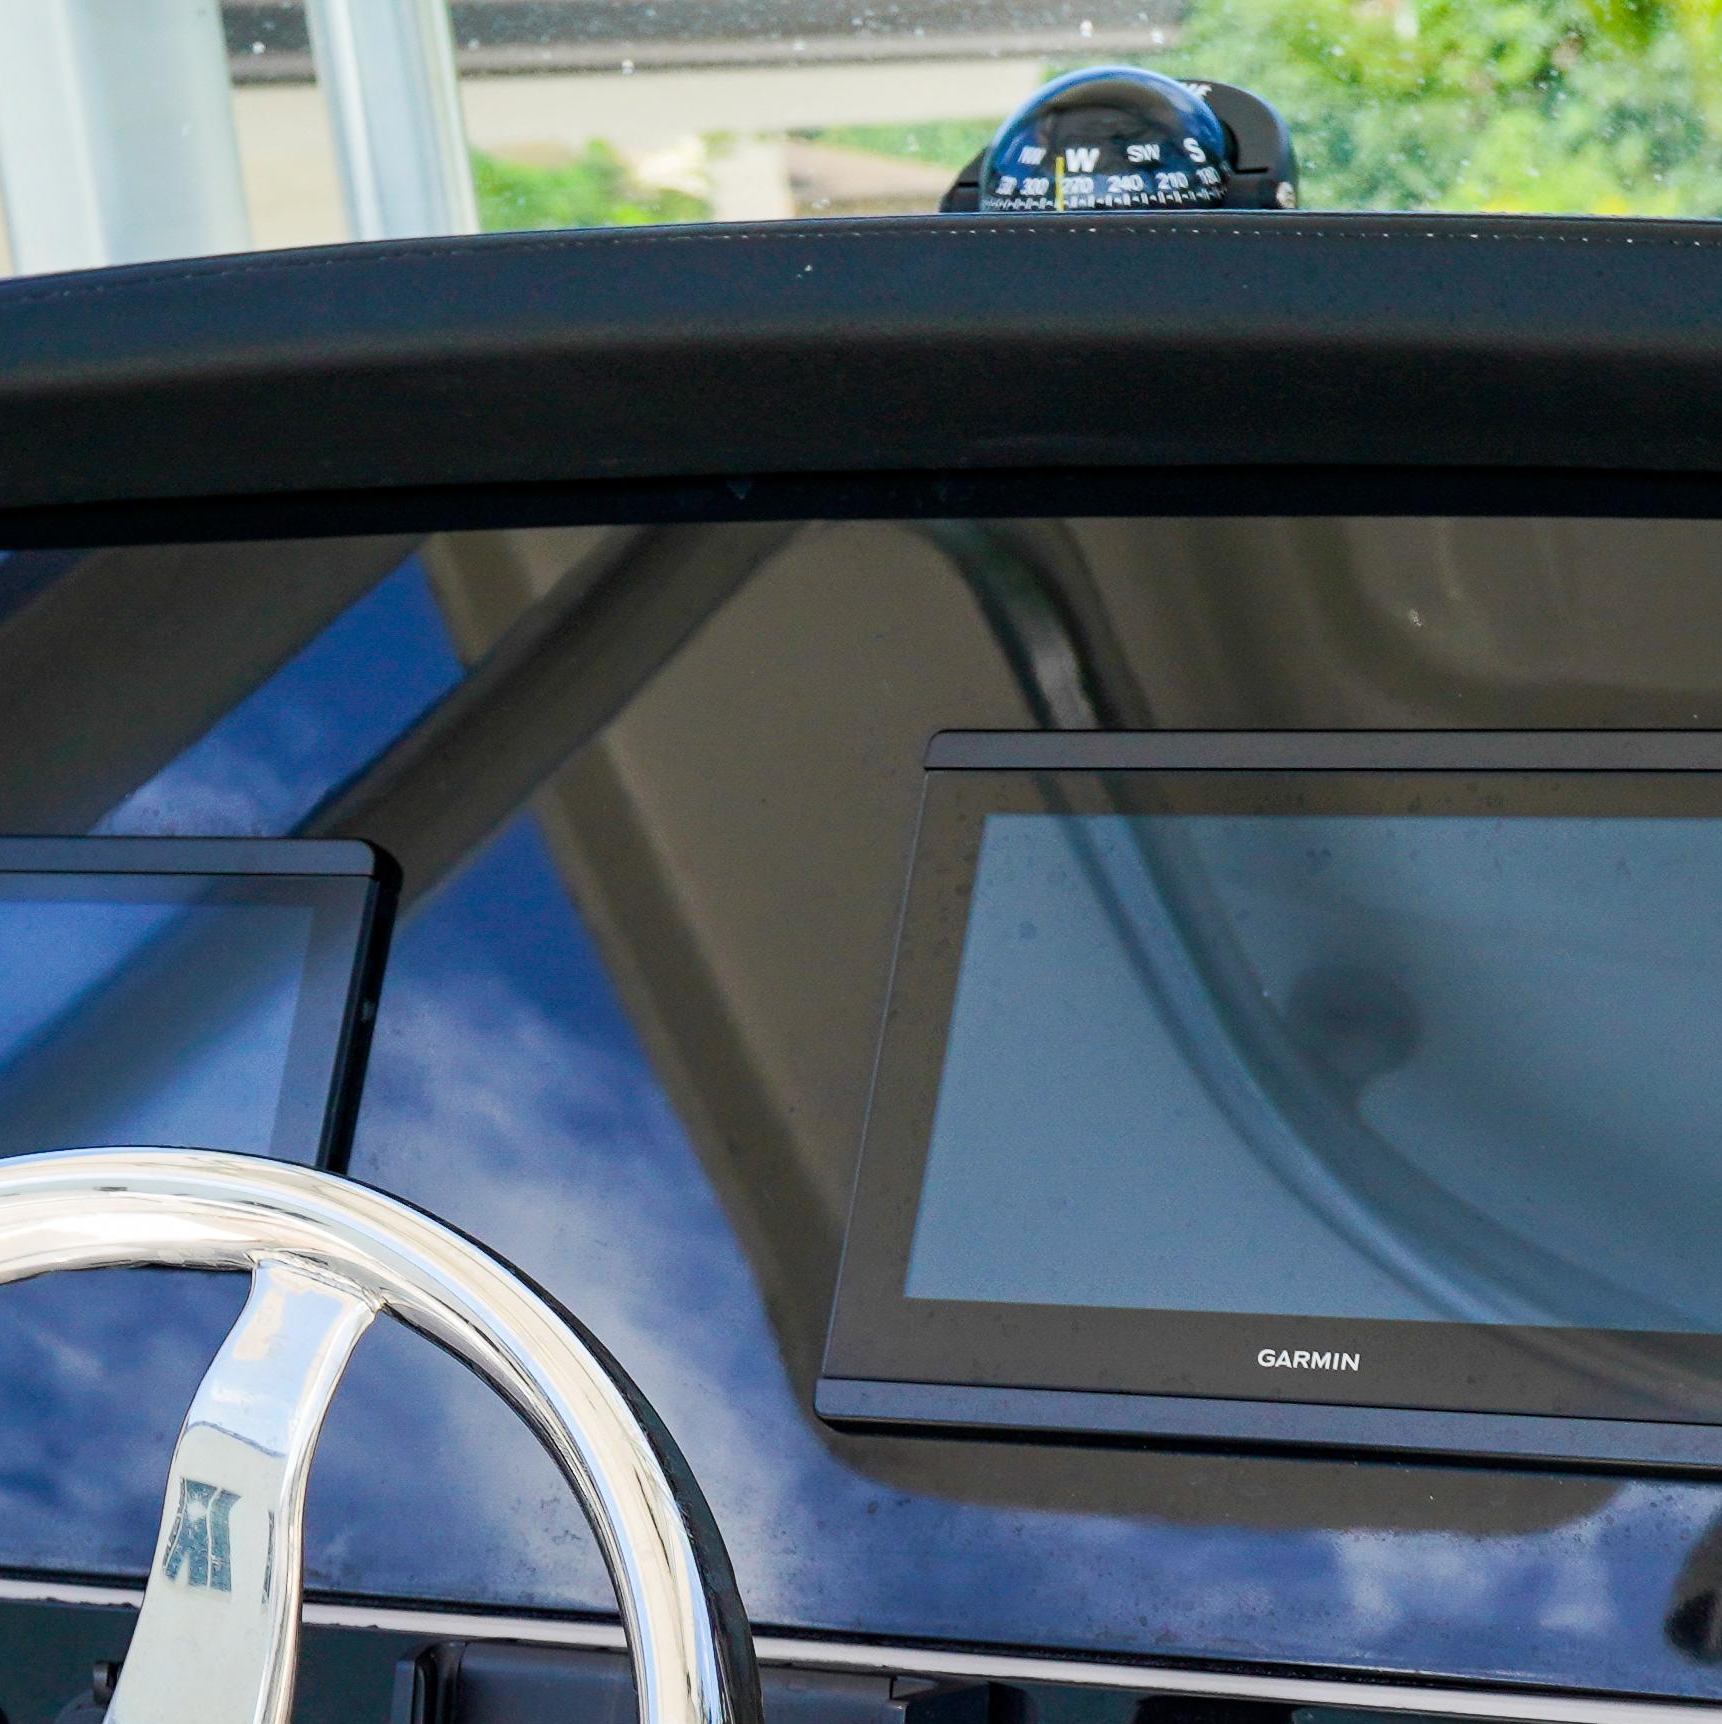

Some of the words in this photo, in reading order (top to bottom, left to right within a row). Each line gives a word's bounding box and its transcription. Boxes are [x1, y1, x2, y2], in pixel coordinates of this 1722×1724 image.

[1065, 147, 1101, 172] W
[1127, 143, 1161, 163] SW
[1183, 137, 1206, 163] S
[1107, 173, 1145, 194] 240
[1256, 1346, 1362, 1373] GARMIN
